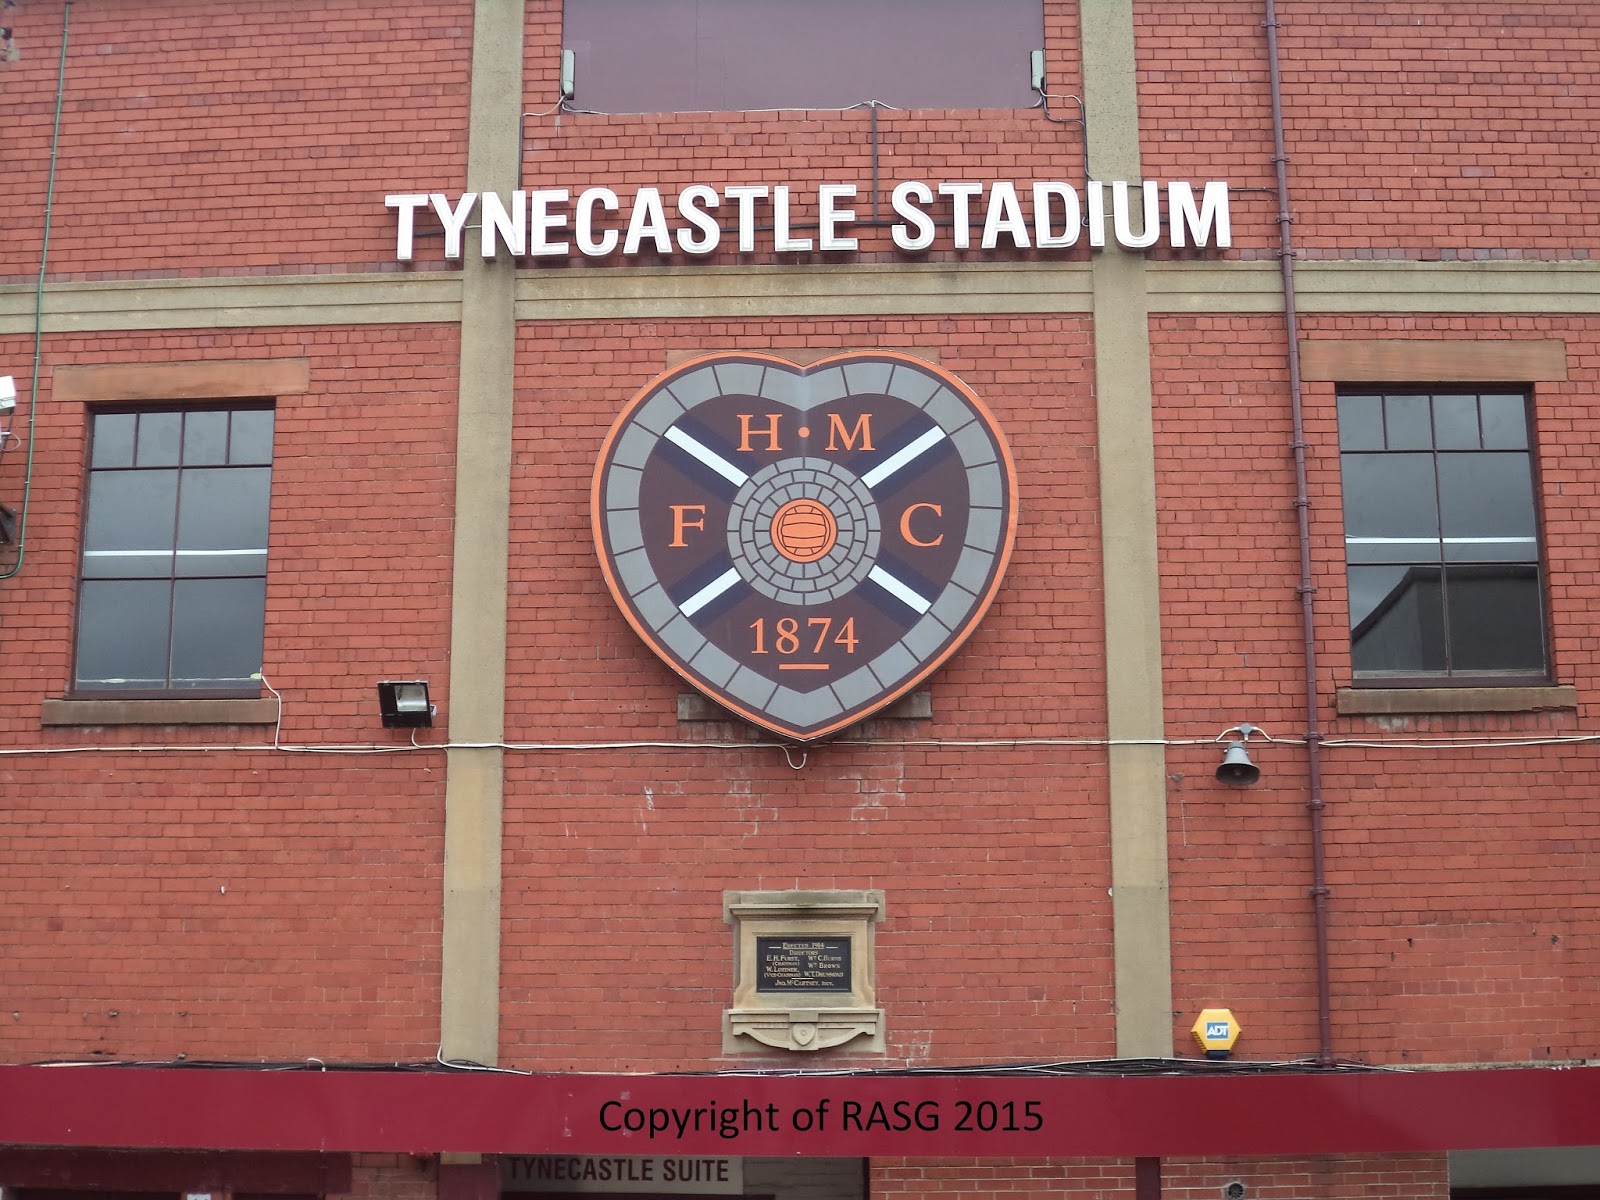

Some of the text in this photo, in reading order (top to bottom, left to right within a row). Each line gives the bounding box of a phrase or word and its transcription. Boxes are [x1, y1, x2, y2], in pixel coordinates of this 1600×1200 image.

[384, 179, 1232, 262] TYNECASTLE STADIUM
[736, 413, 875, 452] H M
[667, 504, 706, 548] F
[900, 502, 944, 547] C
[749, 616, 859, 655] 1874
[1207, 1025, 1228, 1036] ADT
[509, 1157, 729, 1182] TYNECASTLE SUITE
